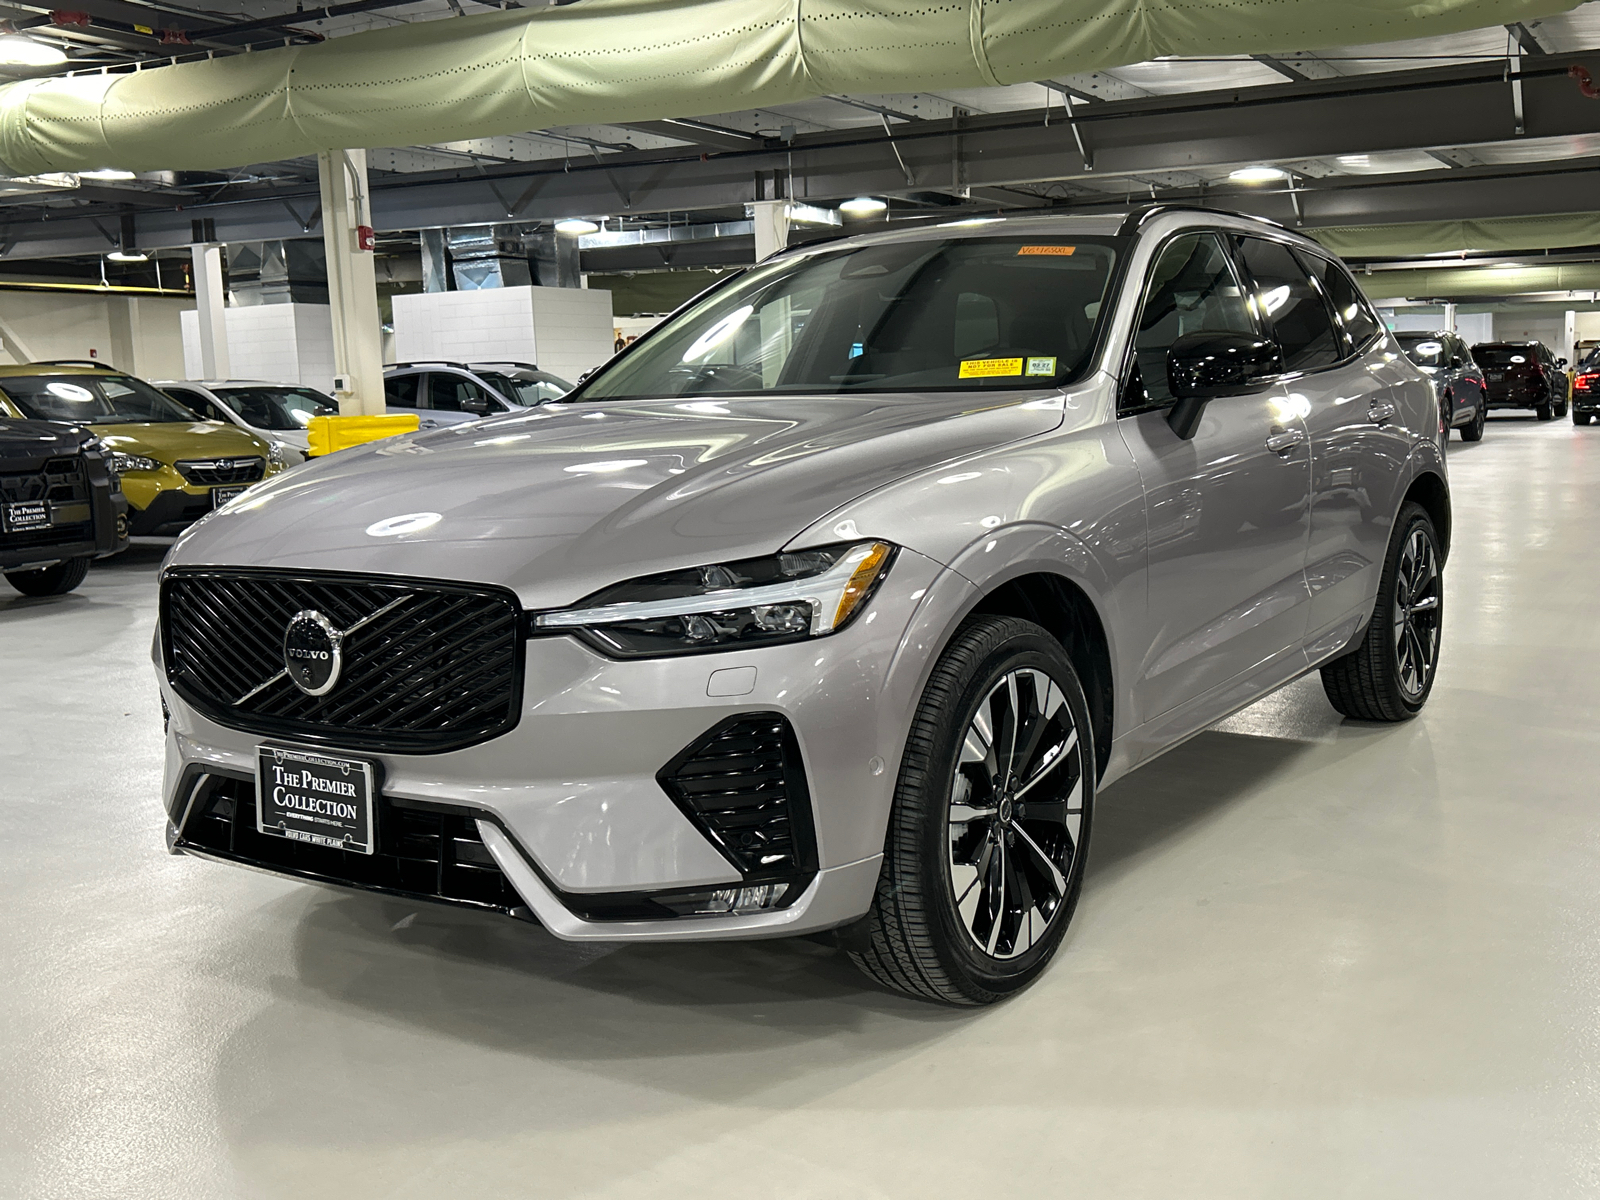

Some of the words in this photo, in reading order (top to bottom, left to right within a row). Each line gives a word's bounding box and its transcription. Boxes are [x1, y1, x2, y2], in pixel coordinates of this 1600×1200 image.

[9, 508, 21, 516] THE
[21, 506, 46, 514] PREMIER
[9, 514, 46, 523] COLLECTION
[287, 648, 329, 660] VOLVO
[272, 765, 300, 788] THE
[301, 770, 357, 798] PREMIER
[272, 786, 357, 820] COLLECTION
[286, 811, 314, 822] EVERYTHING
[285, 830, 299, 840] VOLVO
[299, 832, 311, 842] CARS
[311, 835, 326, 845] WHITE
[326, 838, 344, 848] PLAINS
